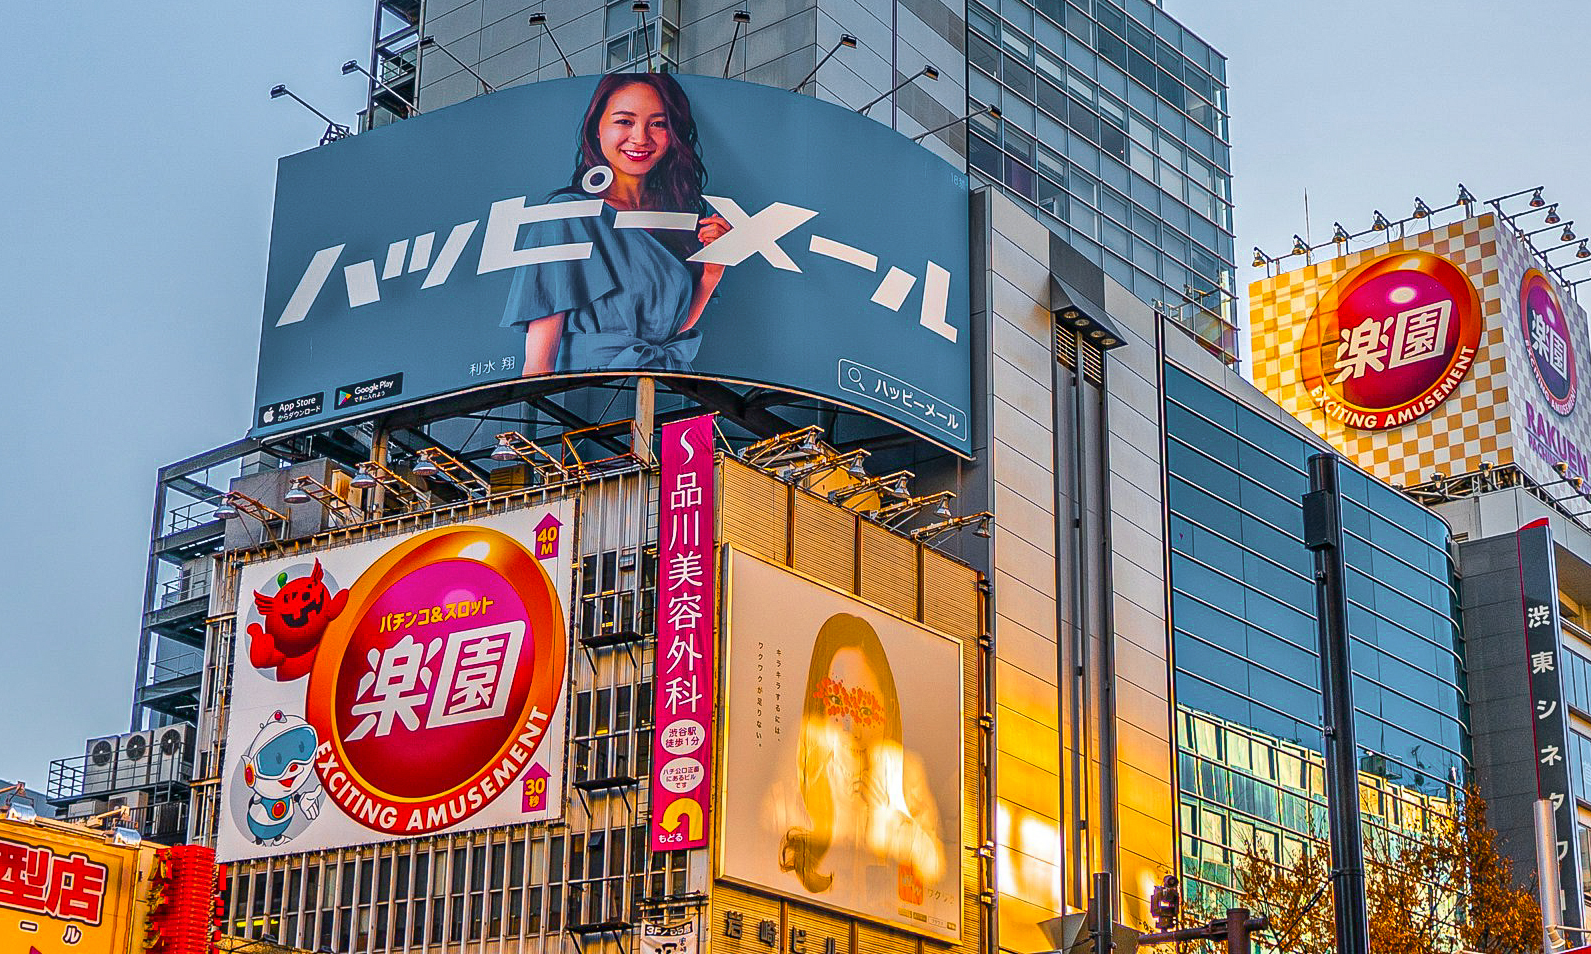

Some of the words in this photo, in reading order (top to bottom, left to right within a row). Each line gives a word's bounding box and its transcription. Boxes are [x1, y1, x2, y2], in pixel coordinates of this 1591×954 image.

[275, 165, 958, 344] ハッピーメール
[1331, 299, 1453, 385] 楽園
[1531, 310, 1568, 382] 楽園
[279, 401, 295, 412] App
[296, 396, 316, 409] Store
[354, 384, 379, 398] Google
[379, 378, 394, 392] Play
[874, 378, 959, 430] ハッピーメール
[1310, 383, 1378, 429] EXCITING
[1384, 345, 1475, 429] AMUSEMENT
[277, 404, 321, 422] からダウンロード
[1525, 400, 1589, 481] RAKUEN
[536, 528, 558, 543] 40
[540, 543, 553, 556] M
[664, 471, 704, 716] 品川美容外科
[379, 596, 495, 633] パチンコ&スロット
[344, 619, 527, 743] 楽園
[665, 736, 700, 748] 徒歩1分
[669, 726, 697, 738] 渋谷駅
[315, 739, 398, 831] EXCITING
[405, 705, 549, 832] AMUSEMENT
[524, 778, 546, 795] 30
[658, 833, 684, 843] もどる
